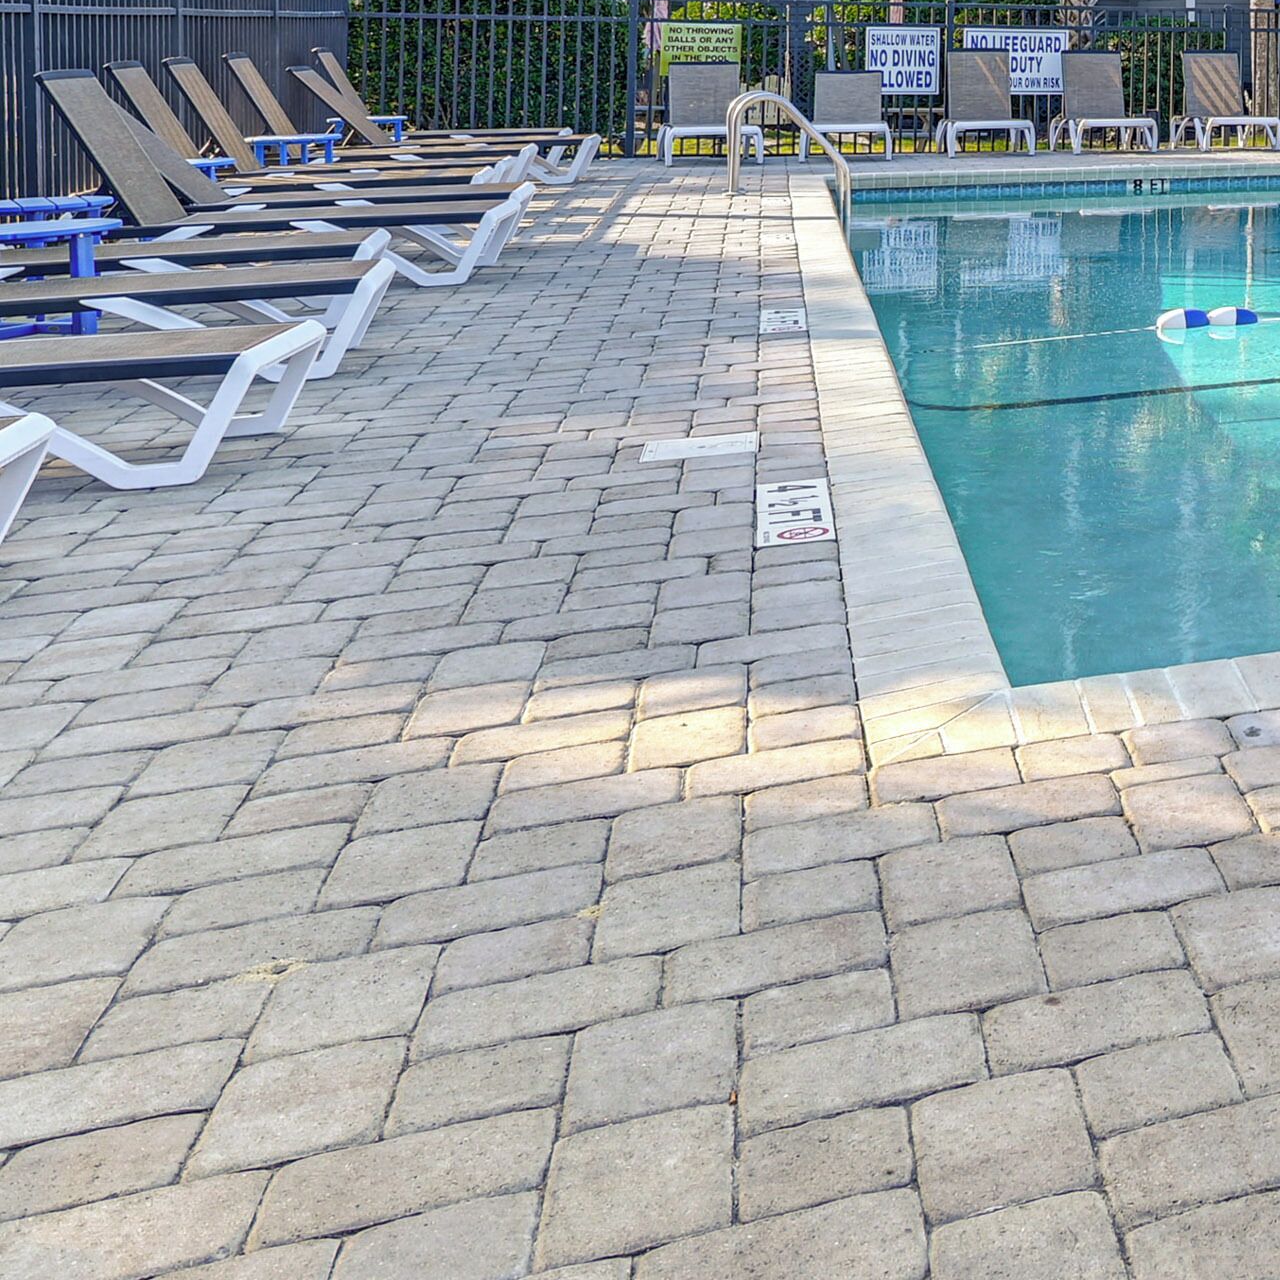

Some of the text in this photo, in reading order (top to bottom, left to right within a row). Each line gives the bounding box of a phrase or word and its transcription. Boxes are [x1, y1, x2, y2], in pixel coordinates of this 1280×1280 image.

[871, 34, 935, 46] SHALLOW WATER
[971, 35, 988, 48] NO
[870, 50, 935, 67] NO DIVING
[1011, 56, 1043, 73] DUTY
[881, 71, 932, 88] LLOWED
[1025, 77, 1040, 88] OWN
[1043, 78, 1060, 88] RISK
